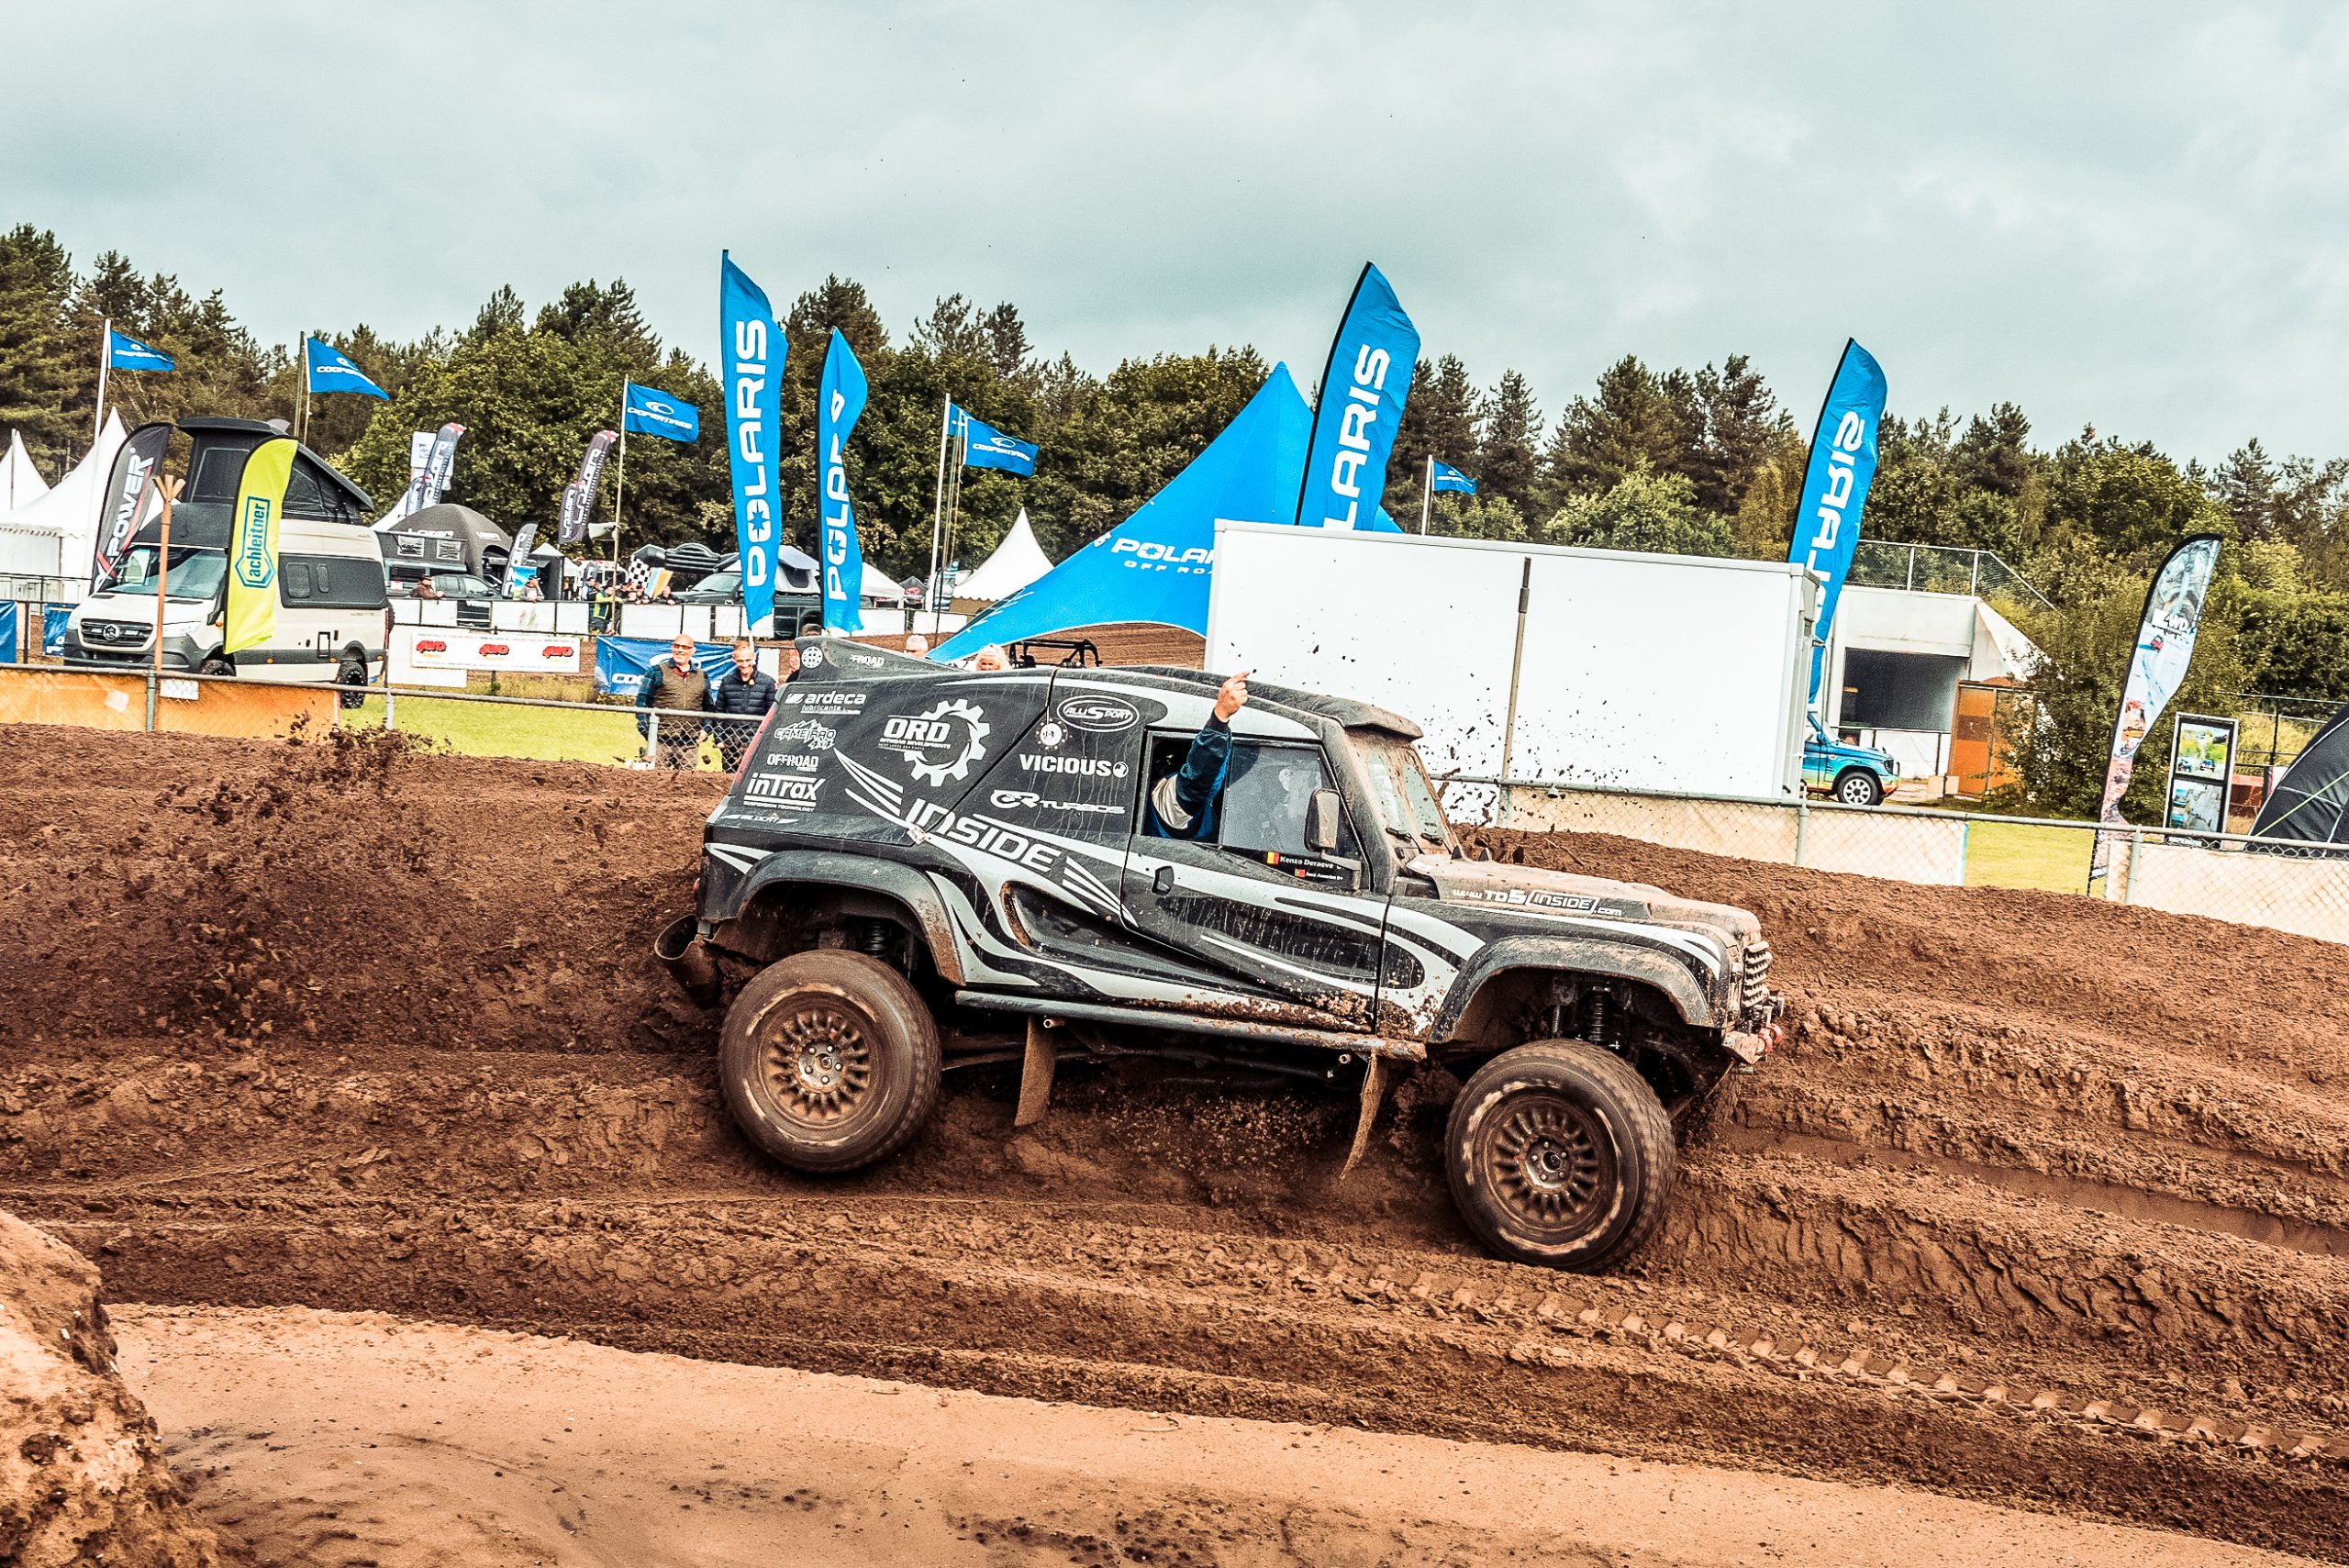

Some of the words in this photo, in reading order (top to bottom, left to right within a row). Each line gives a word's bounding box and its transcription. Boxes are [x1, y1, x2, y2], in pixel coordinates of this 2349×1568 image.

[736, 319, 771, 587] POLARIS
[246, 503, 266, 578] achleitner
[1123, 560, 1167, 572] OFF
[805, 690, 867, 705] ardeca
[883, 718, 952, 742] ORD
[767, 753, 819, 768] OFFROAD
[1019, 754, 1112, 777] VICIOUS
[1279, 855, 1303, 864] Kenzo
[1304, 859, 1334, 869] Deraeve
